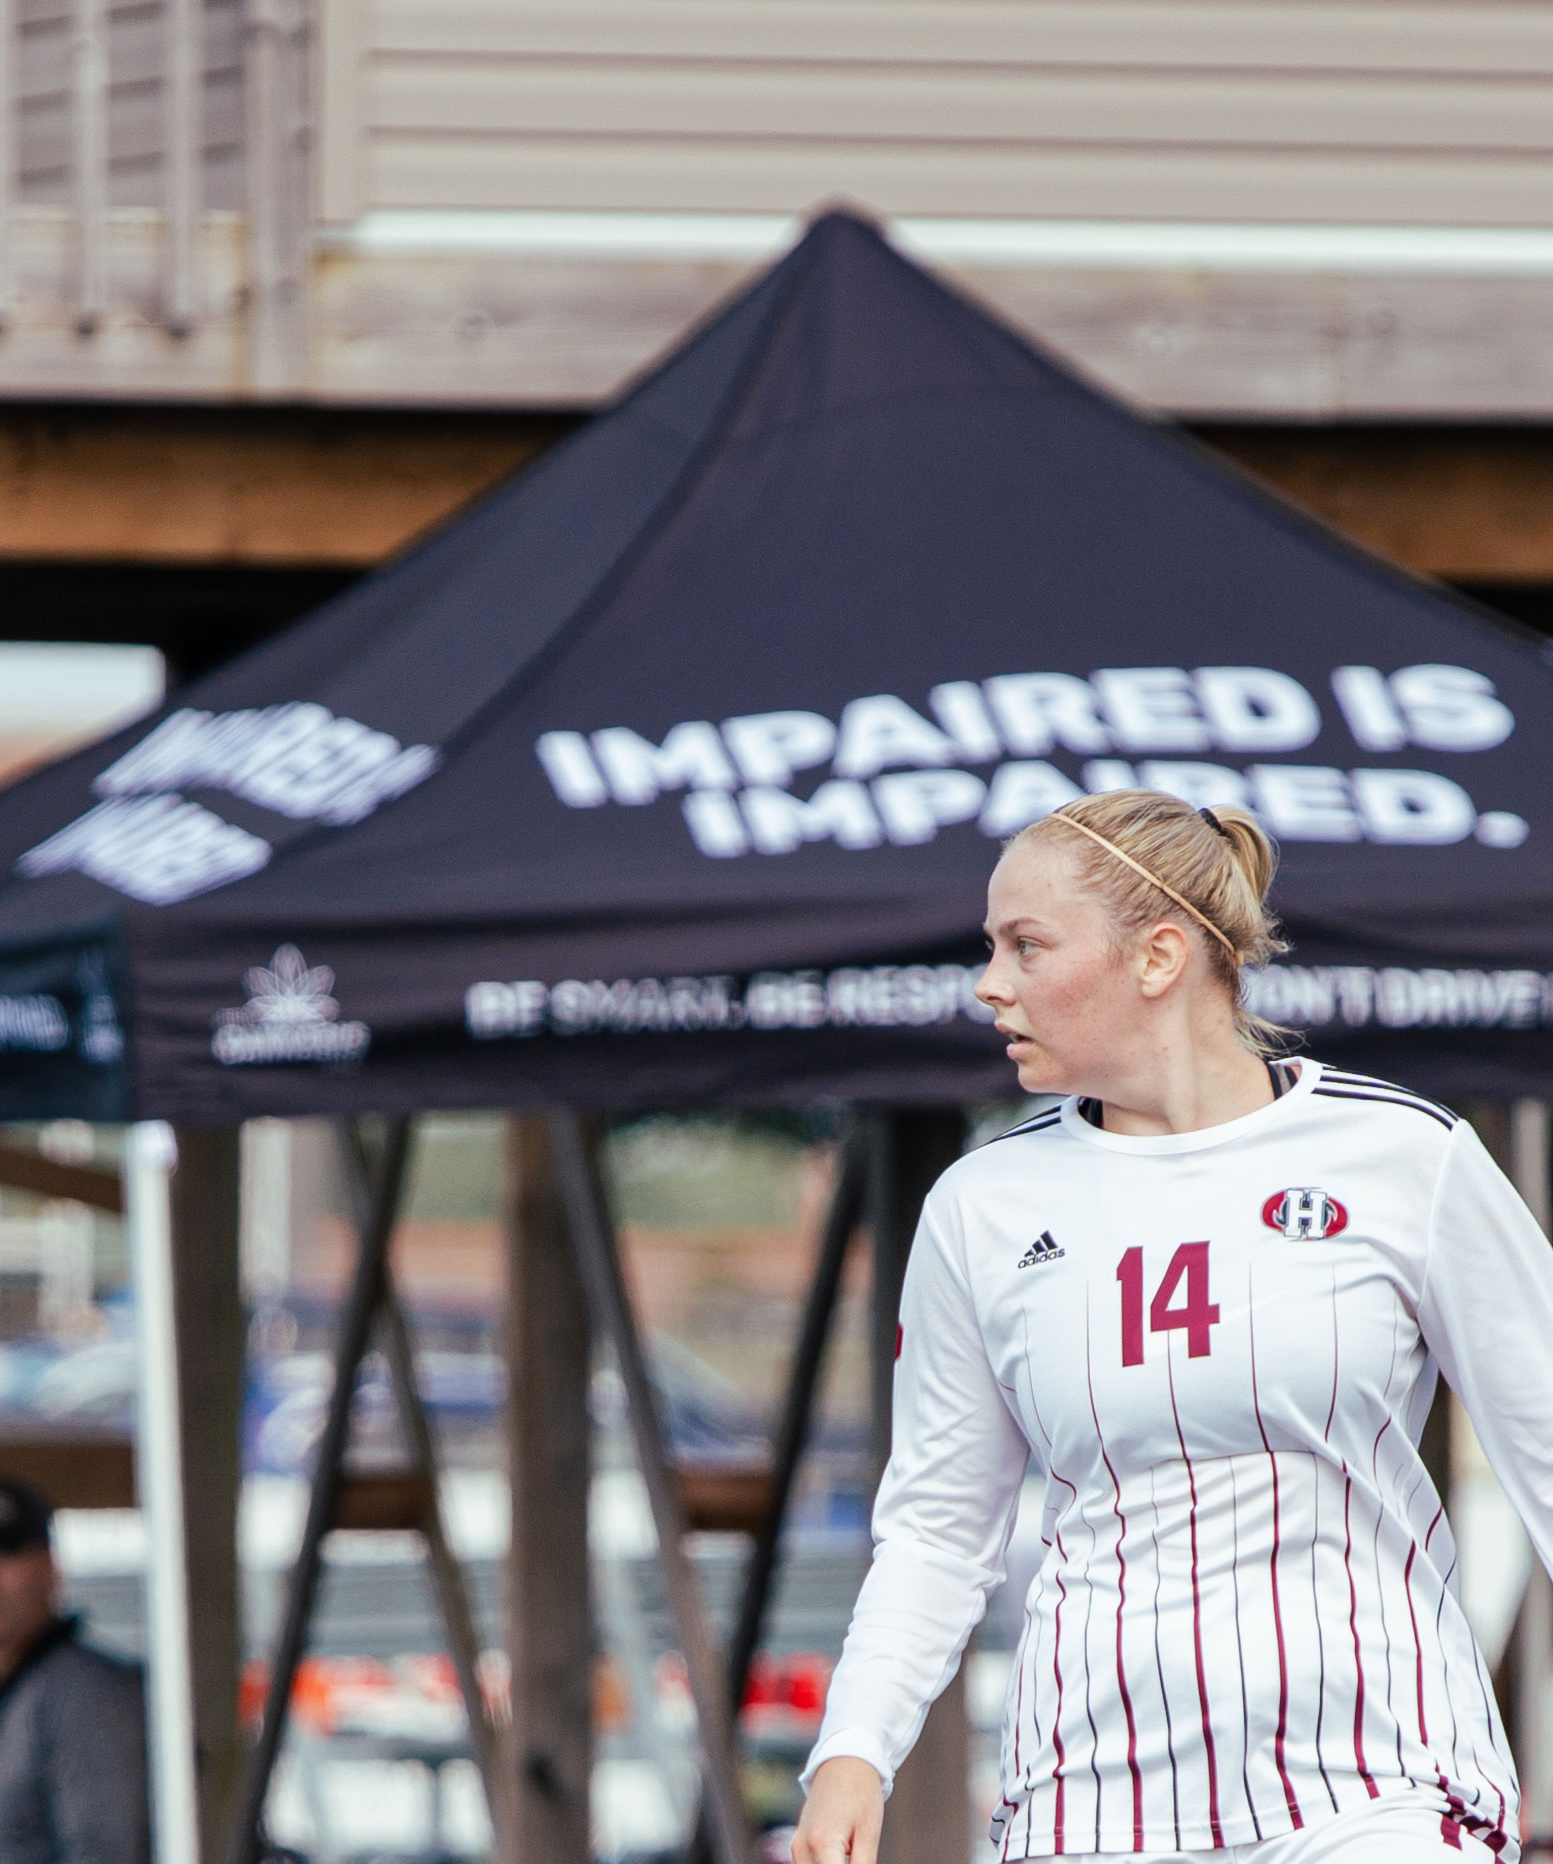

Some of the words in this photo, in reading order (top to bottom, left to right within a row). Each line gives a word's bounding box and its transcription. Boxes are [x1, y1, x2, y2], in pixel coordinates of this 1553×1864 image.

[536, 665, 1322, 810] IMPAIRED
[1330, 663, 1516, 754] IS
[1018, 1248, 1065, 1269] adidas
[1116, 1240, 1220, 1367] 14
